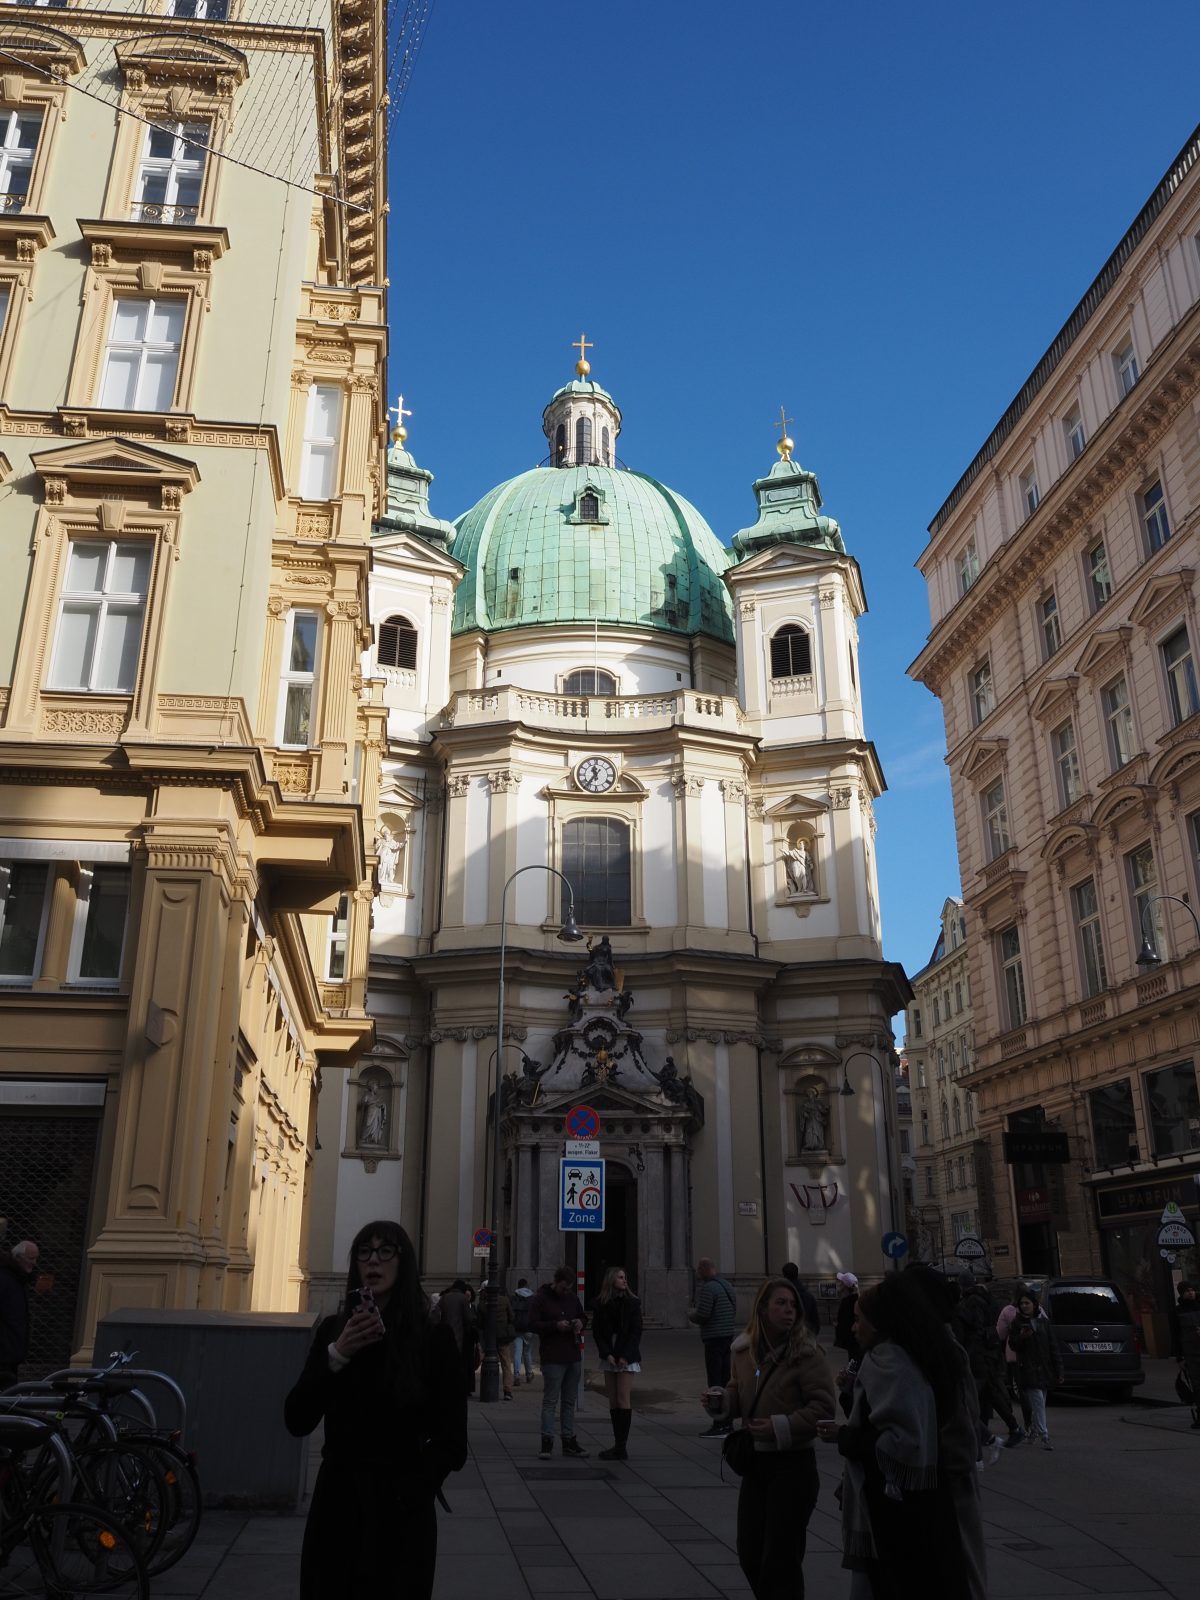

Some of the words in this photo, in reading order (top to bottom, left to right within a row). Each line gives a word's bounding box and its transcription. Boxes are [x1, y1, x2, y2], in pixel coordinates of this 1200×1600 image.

[585, 1193, 598, 1206] 20
[568, 1211, 596, 1223] Zone
[1164, 1225, 1187, 1234] AUTOBUS
